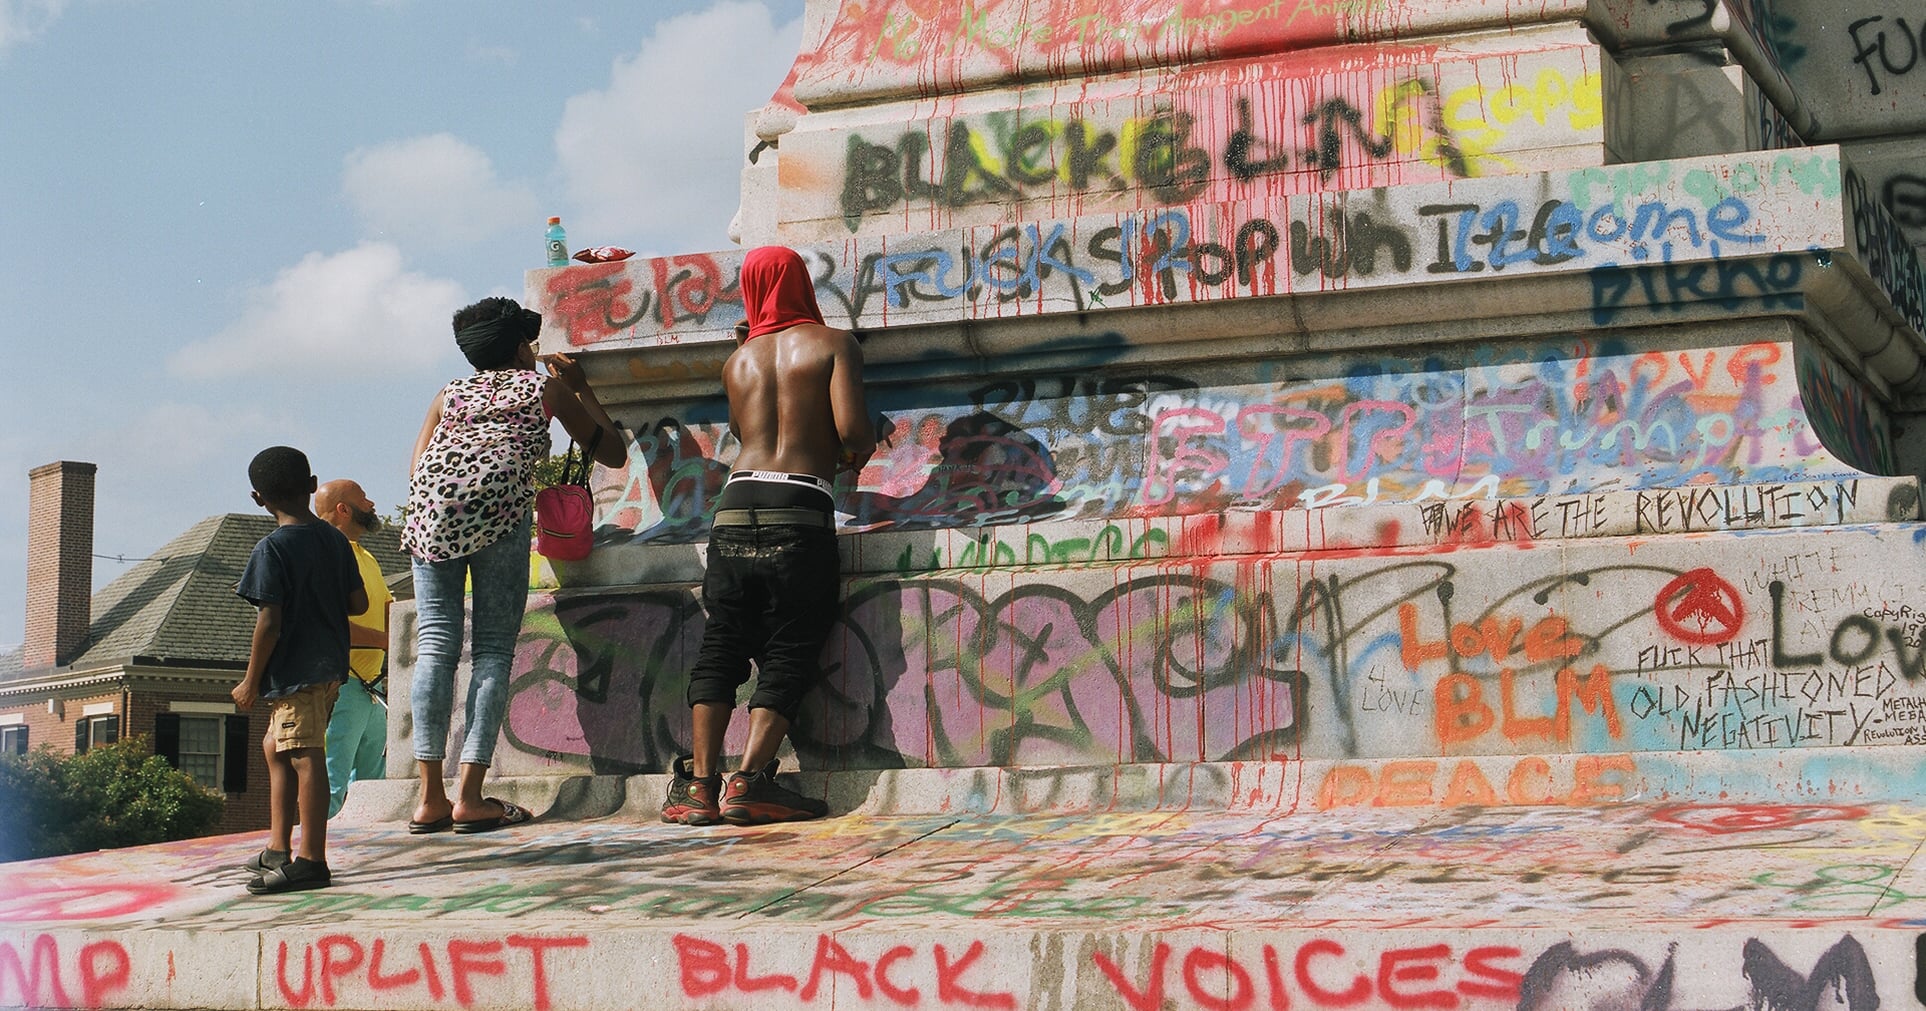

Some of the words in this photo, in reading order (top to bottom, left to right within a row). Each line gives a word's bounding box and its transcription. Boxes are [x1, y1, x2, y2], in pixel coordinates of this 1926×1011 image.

[868, 7, 921, 64] No
[1848, 14, 1926, 96] FU
[551, 241, 560, 252] G
[872, 223, 1095, 307] FUCK
[1485, 498, 1549, 541] ARE
[1556, 494, 1606, 538] THE
[1636, 479, 1860, 534] REVOLUTION
[1717, 638, 1771, 671] THAT
[1361, 686, 1424, 716] LOVE
[1434, 664, 1622, 752] BLM
[1631, 685, 1690, 719] OLD
[1706, 661, 1897, 720] FASHIONED
[275, 933, 591, 1011] UPLIFT
[672, 930, 1018, 1010] BLACK
[1094, 938, 1525, 1011] VOICES
